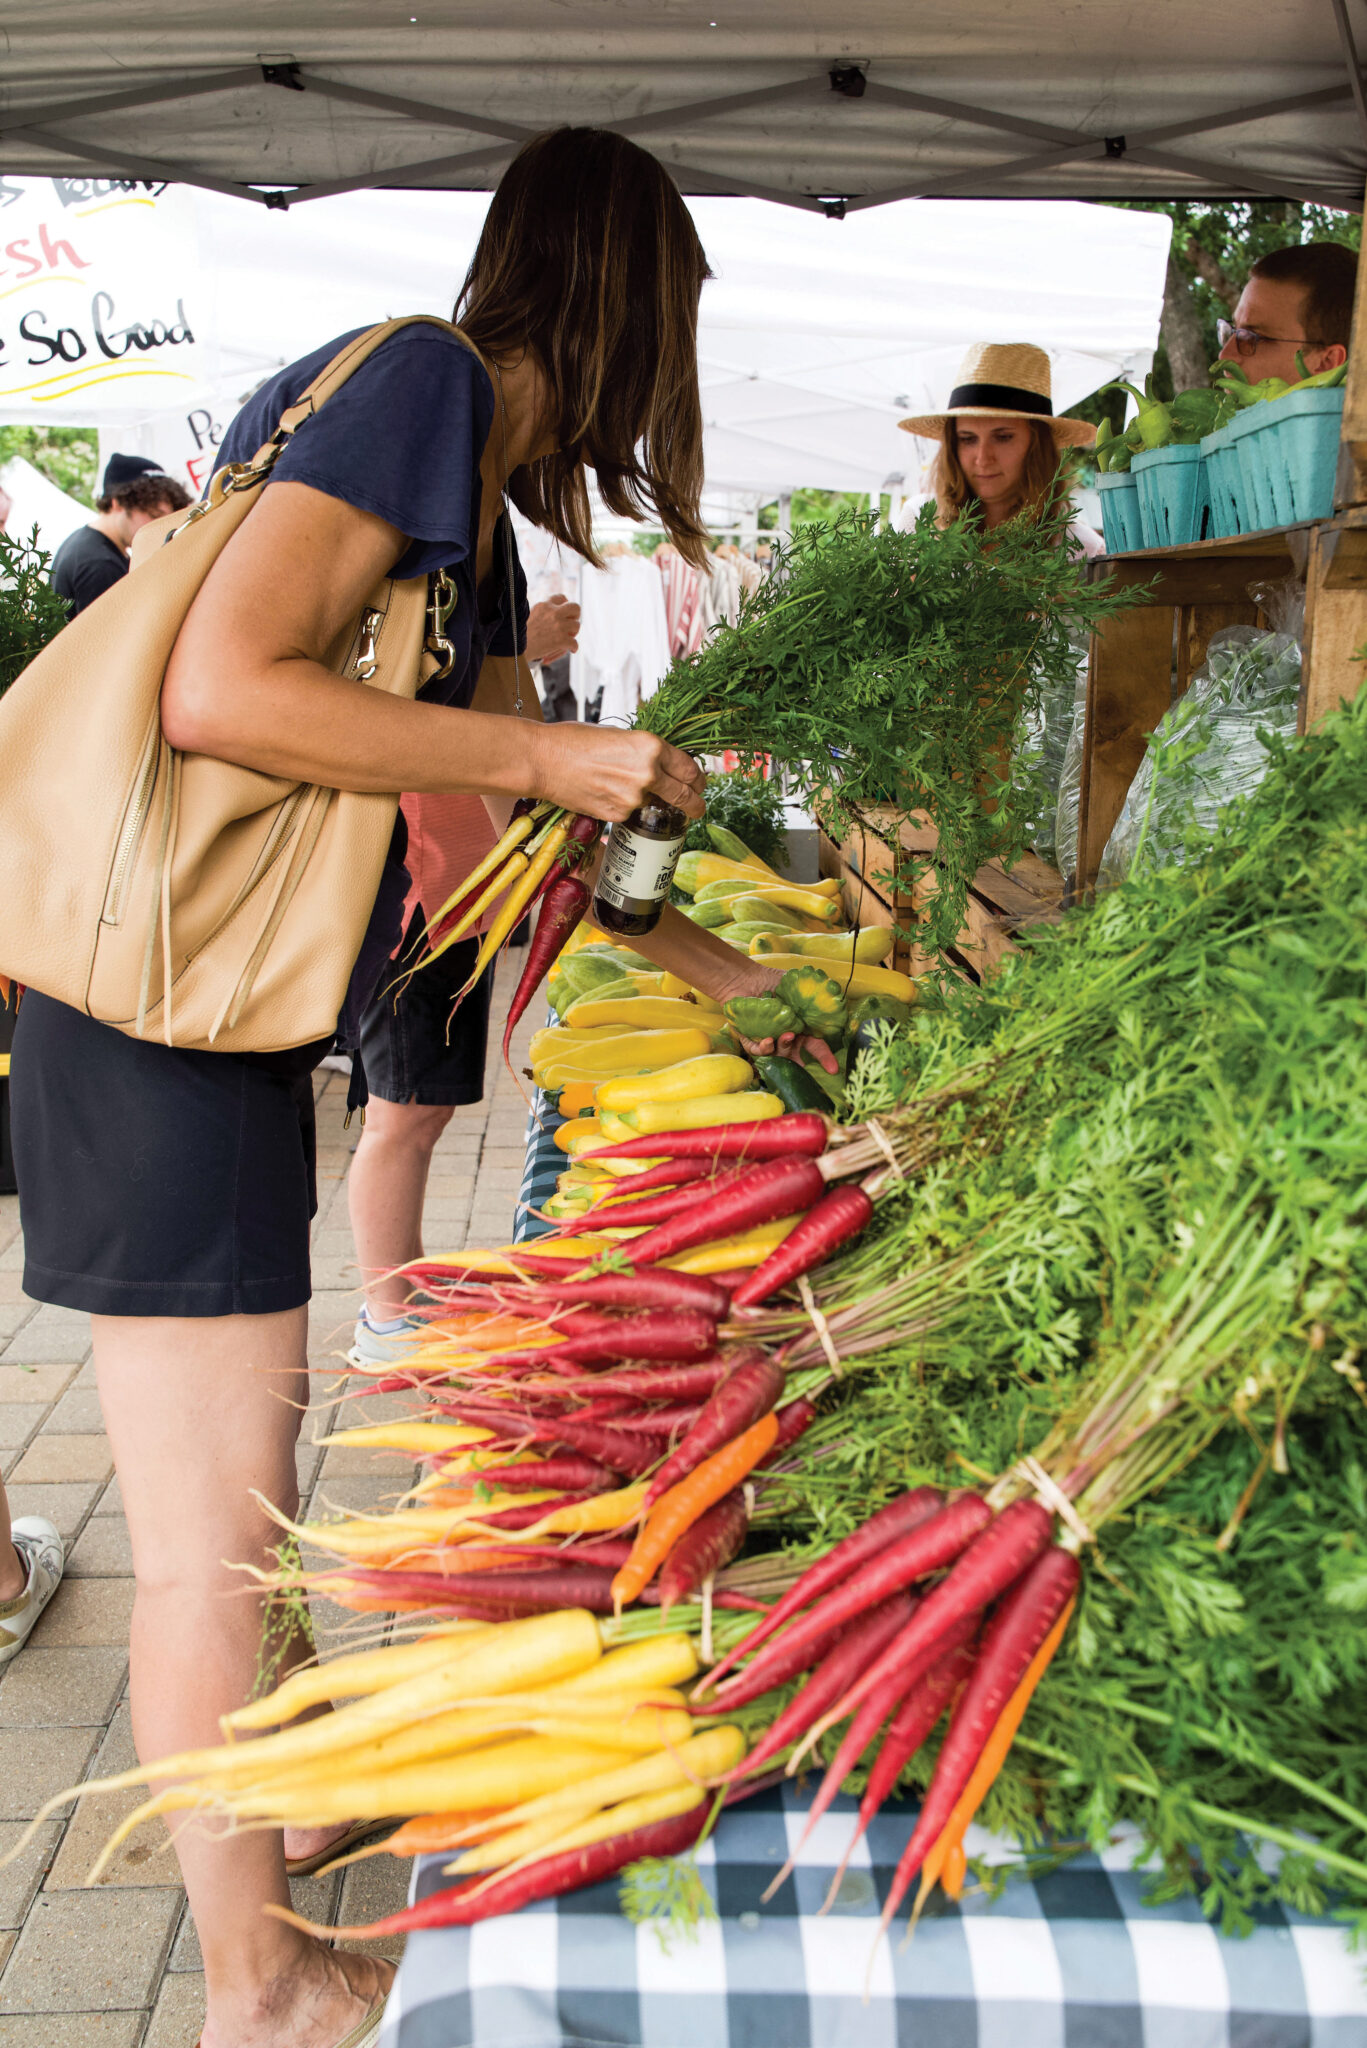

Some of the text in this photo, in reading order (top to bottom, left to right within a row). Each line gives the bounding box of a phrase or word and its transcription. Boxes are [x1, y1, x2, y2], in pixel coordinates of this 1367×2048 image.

[0, 223, 92, 279] sh
[19, 310, 87, 366] So
[92, 291, 195, 359] Good
[187, 409, 222, 450] Pe
